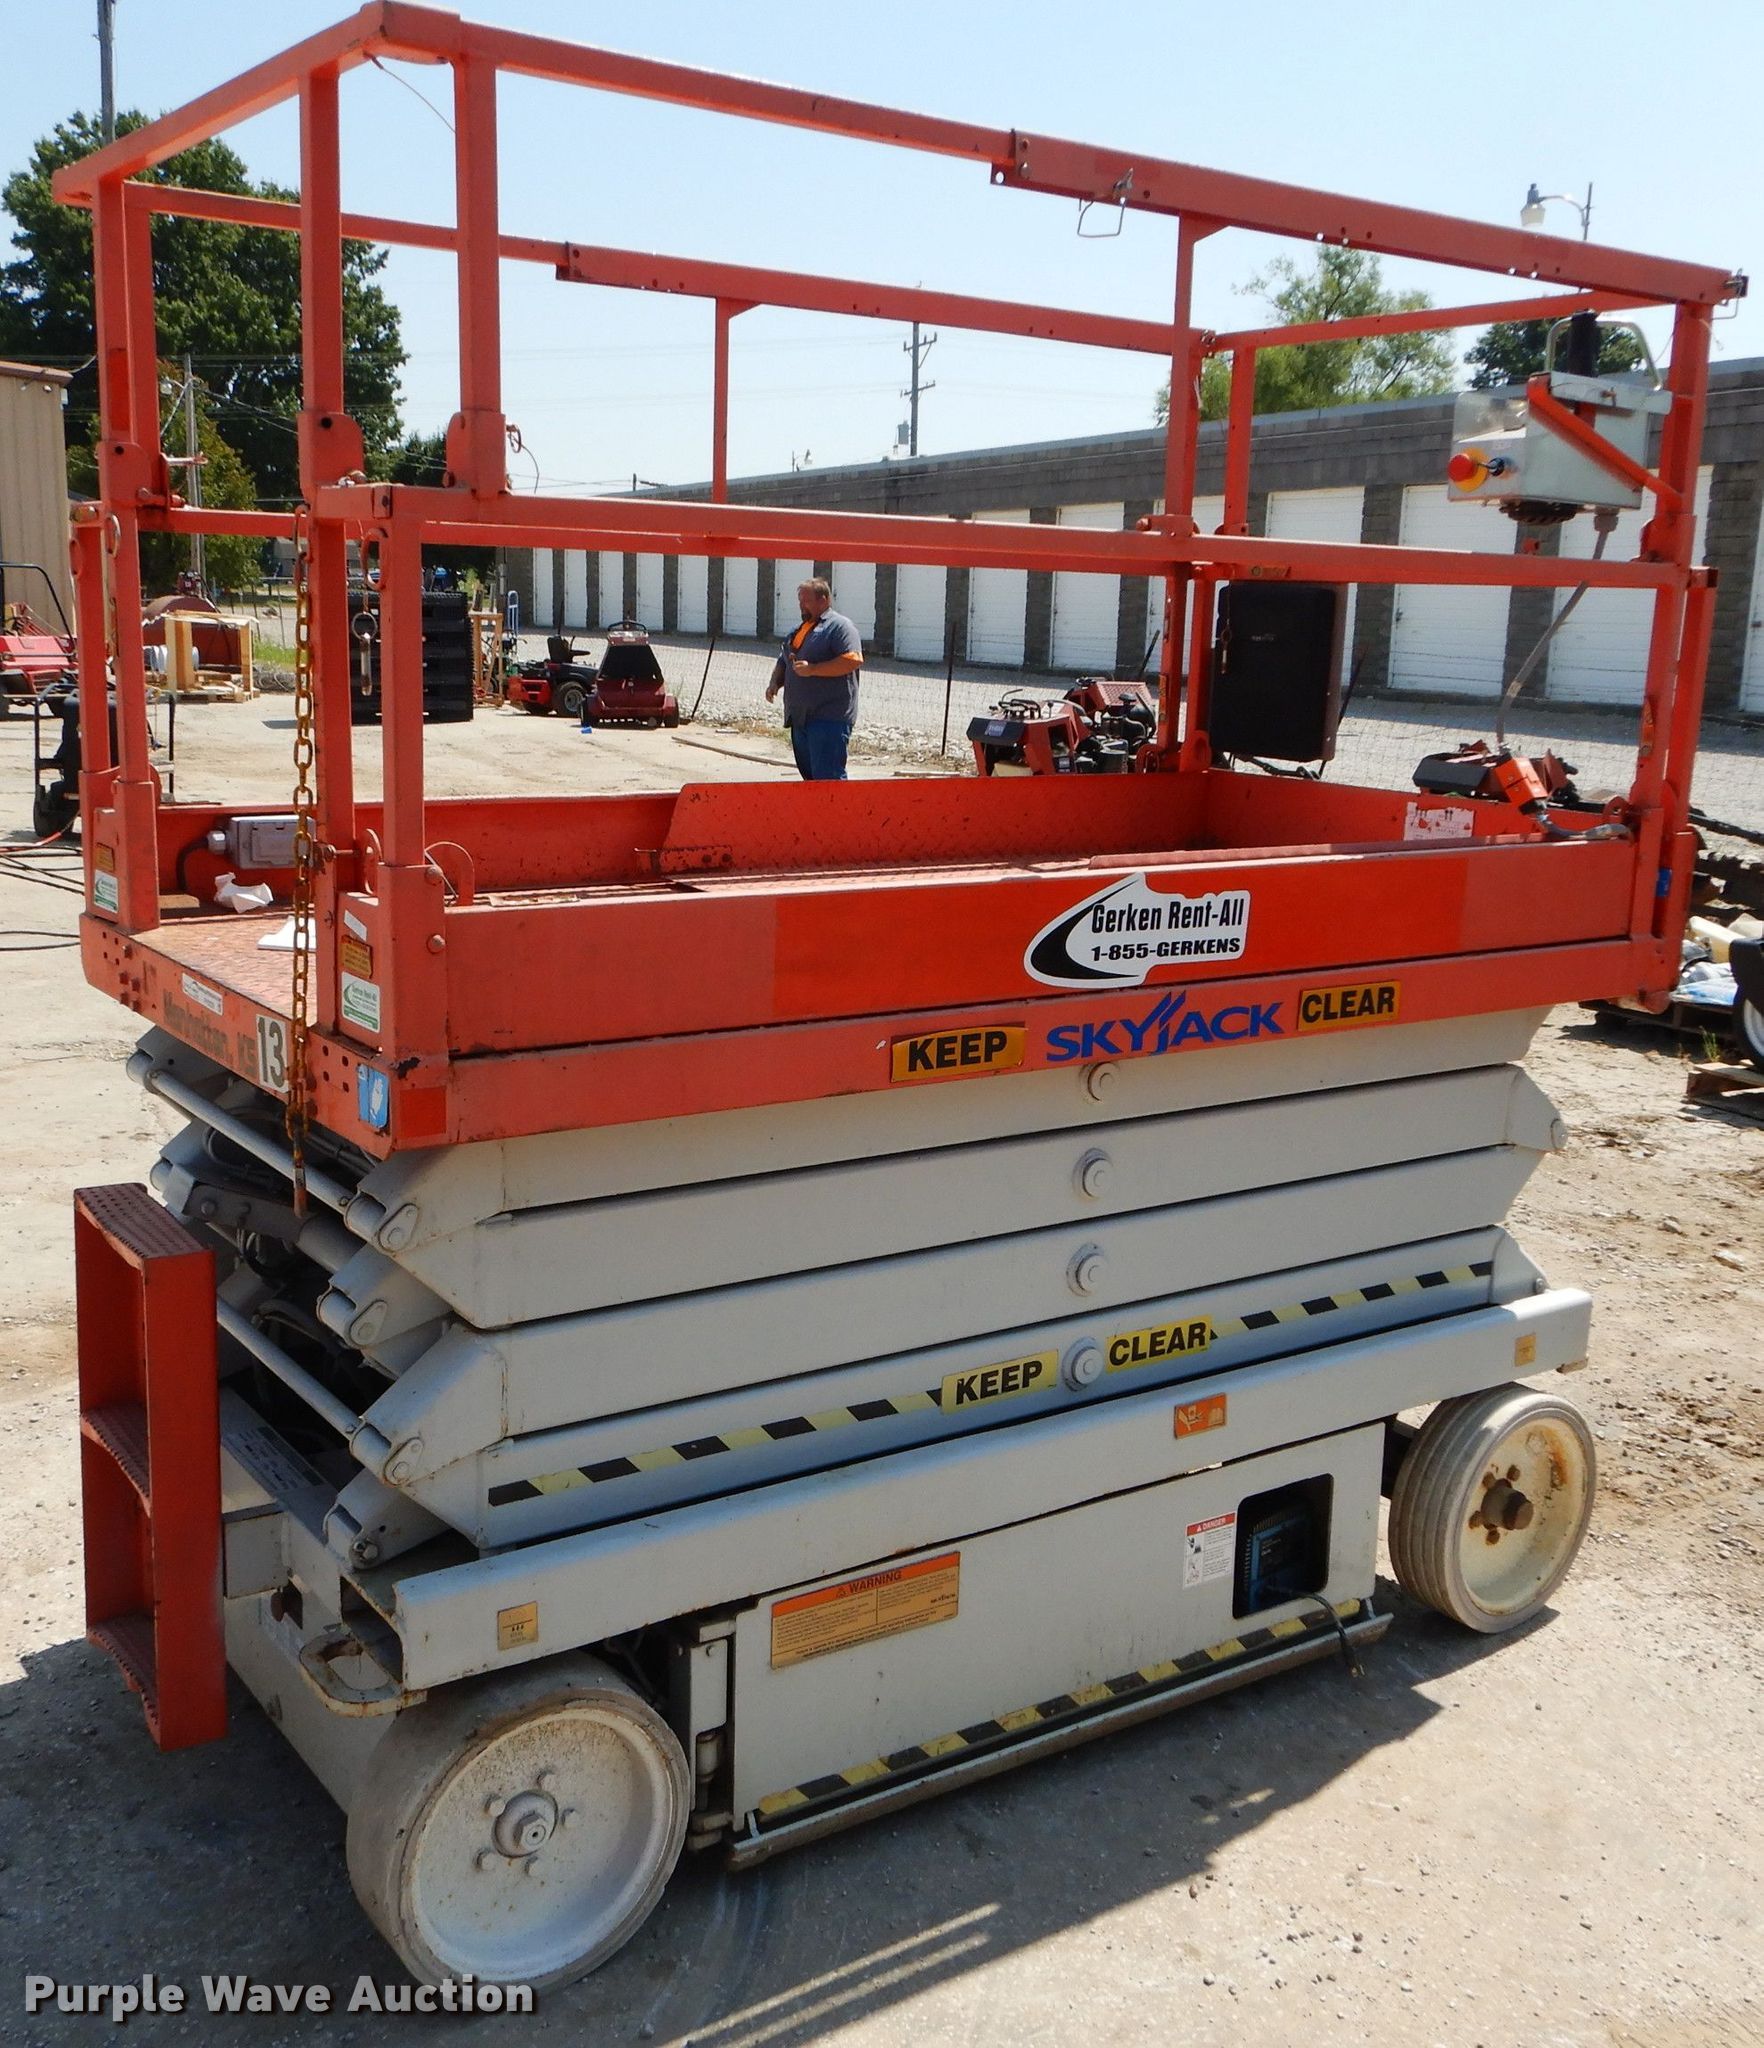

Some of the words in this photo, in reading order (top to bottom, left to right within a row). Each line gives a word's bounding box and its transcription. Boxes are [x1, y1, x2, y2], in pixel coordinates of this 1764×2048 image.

[1092, 903, 1162, 933] Gerken
[1167, 899, 1245, 929] Rent-All
[1091, 938, 1241, 962] 1-855-GERKENS
[1301, 986, 1396, 1024] CLEAR
[1046, 990, 1284, 1062] SKYJACK
[257, 1016, 286, 1089] 13
[907, 1030, 1008, 1072] KEEP
[955, 1360, 1043, 1405] KEEP
[1109, 1321, 1207, 1367] CLEAR
[1202, 1517, 1227, 1530] DANGER
[848, 1571, 903, 1594] WARNING
